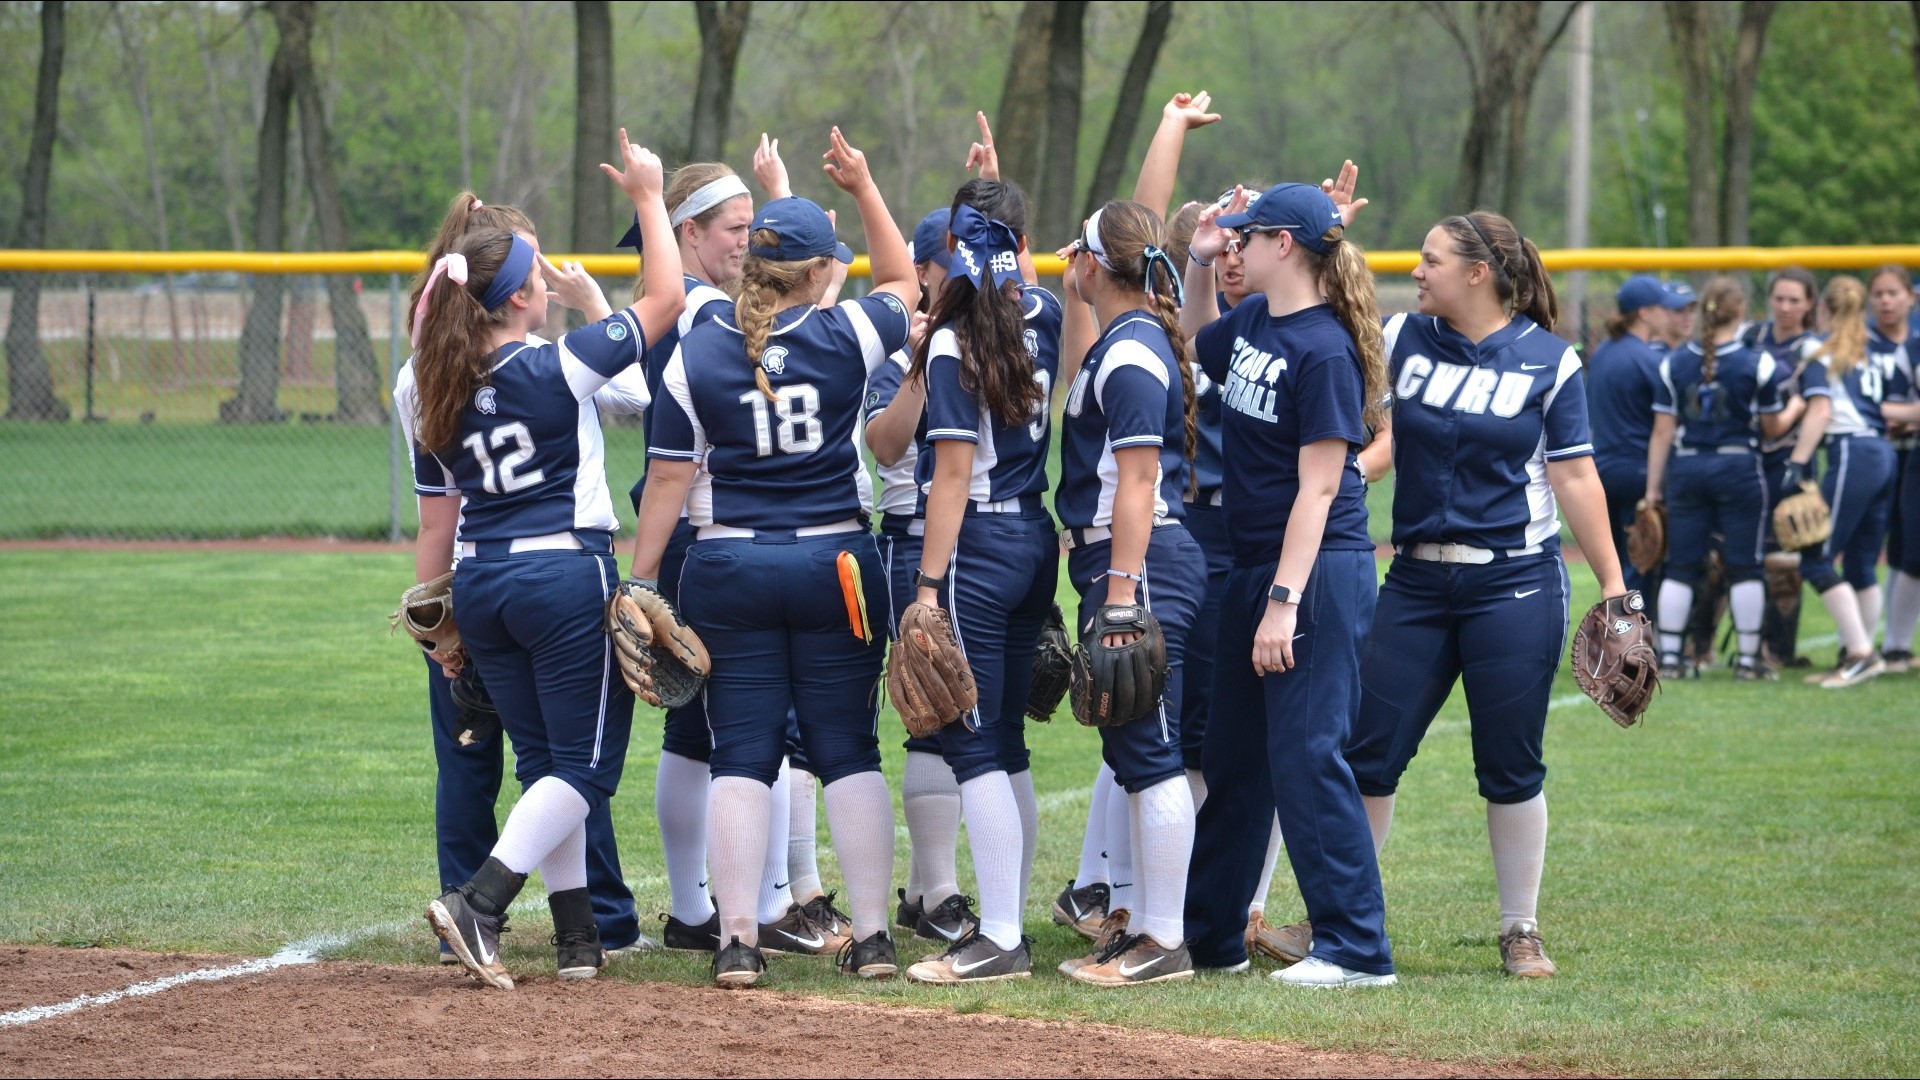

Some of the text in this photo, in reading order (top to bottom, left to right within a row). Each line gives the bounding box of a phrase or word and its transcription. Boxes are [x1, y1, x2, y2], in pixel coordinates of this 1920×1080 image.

[990, 250, 1018, 274] #9
[739, 383, 824, 458] 18
[1395, 353, 1535, 419] CWRU
[461, 421, 547, 494] 12
